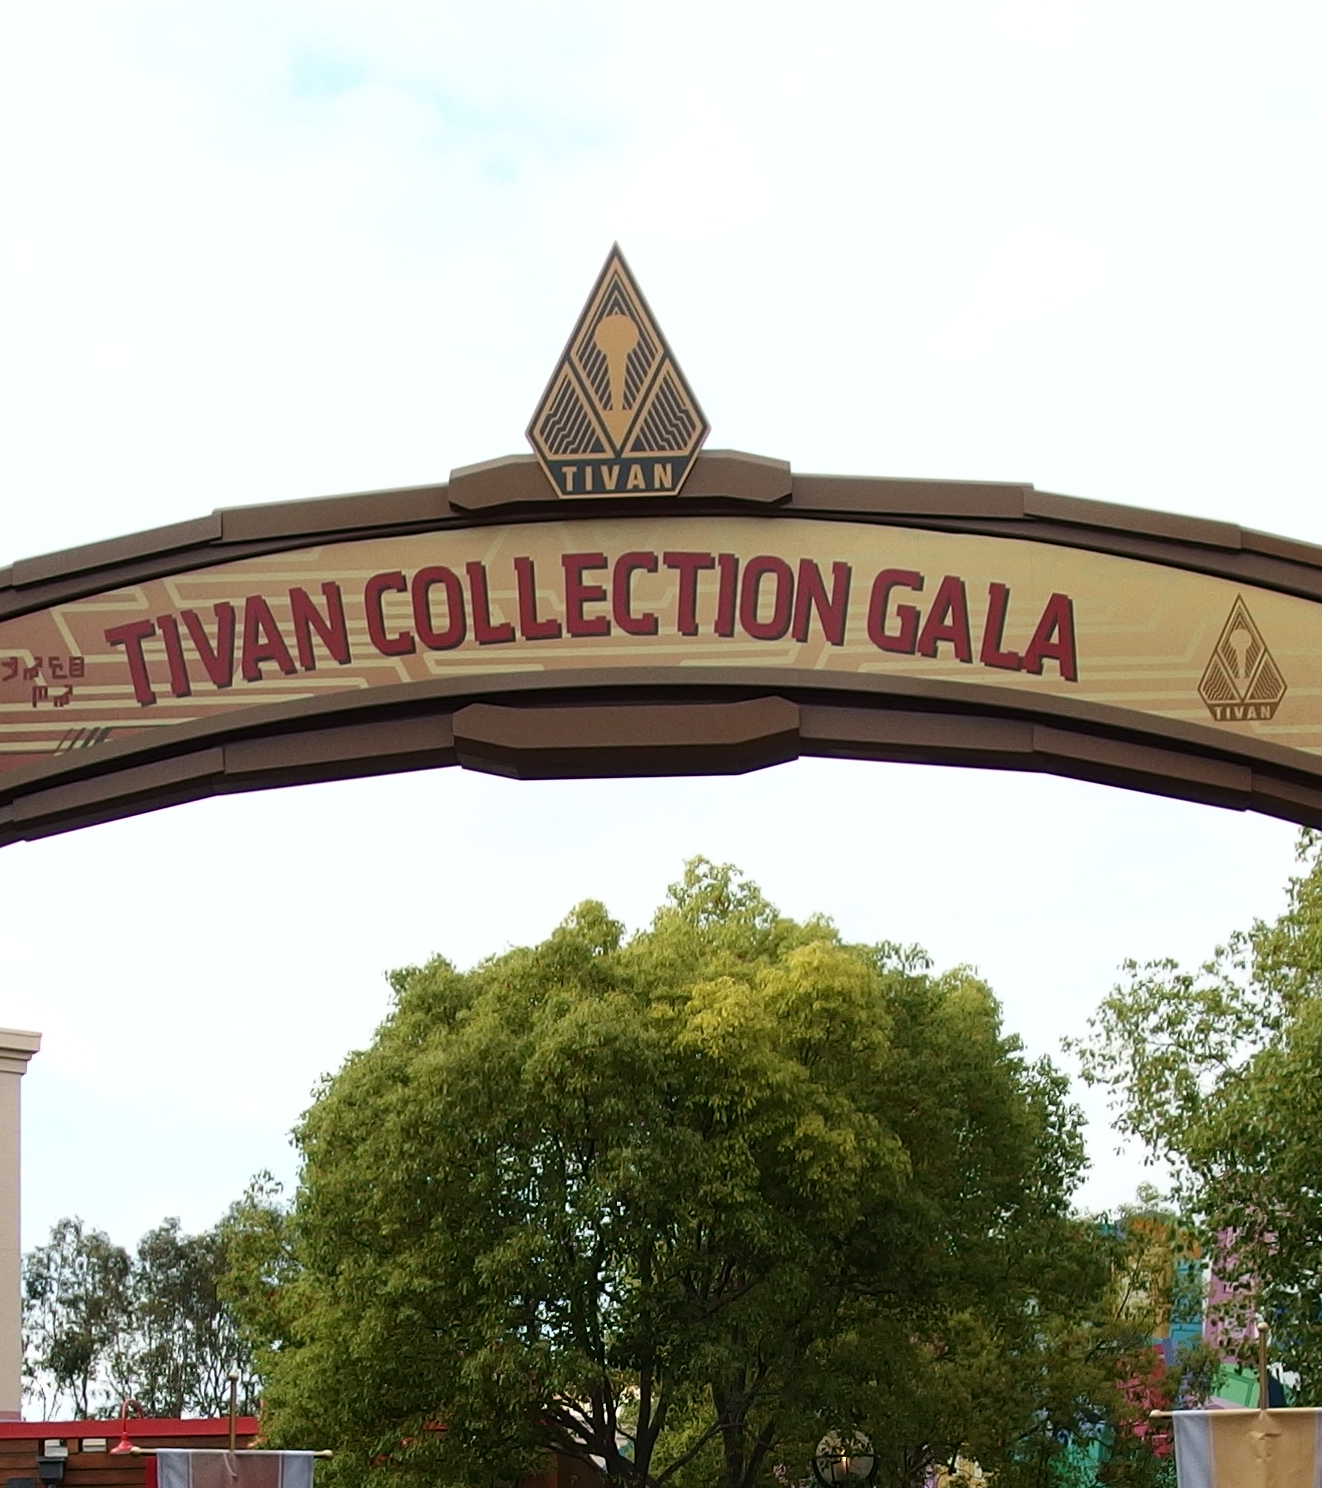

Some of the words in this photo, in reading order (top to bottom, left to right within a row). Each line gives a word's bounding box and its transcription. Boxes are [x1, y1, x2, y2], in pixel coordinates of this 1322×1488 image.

[561, 464, 673, 491] TIVAN
[105, 580, 352, 707] TIVAN
[364, 550, 852, 659] COLLECTION
[867, 568, 1079, 683] GALA
[1214, 704, 1272, 722] TIVAN
